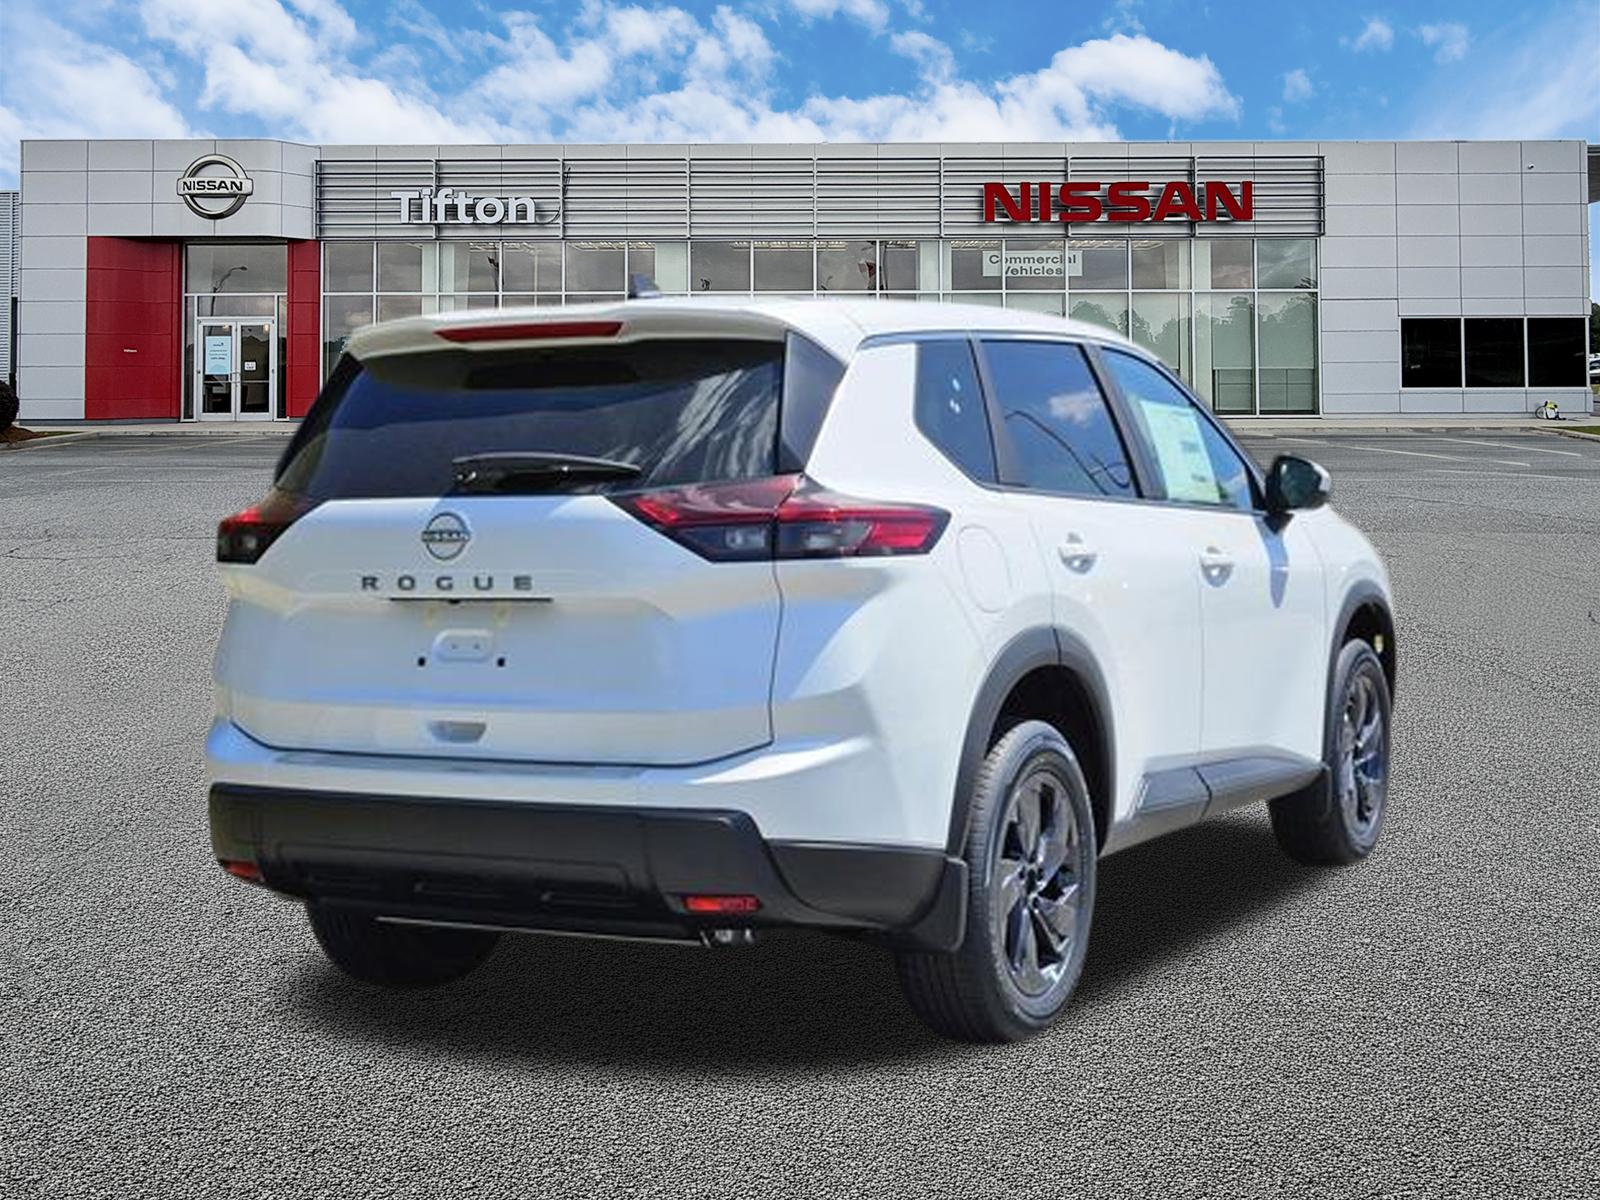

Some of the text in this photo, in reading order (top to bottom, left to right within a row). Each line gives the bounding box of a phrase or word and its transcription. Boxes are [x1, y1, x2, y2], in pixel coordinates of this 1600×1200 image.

[182, 180, 243, 191] NISSAN
[391, 188, 535, 224] Tifton
[983, 181, 1253, 222] NISSAN
[361, 575, 532, 590] ROGUE
